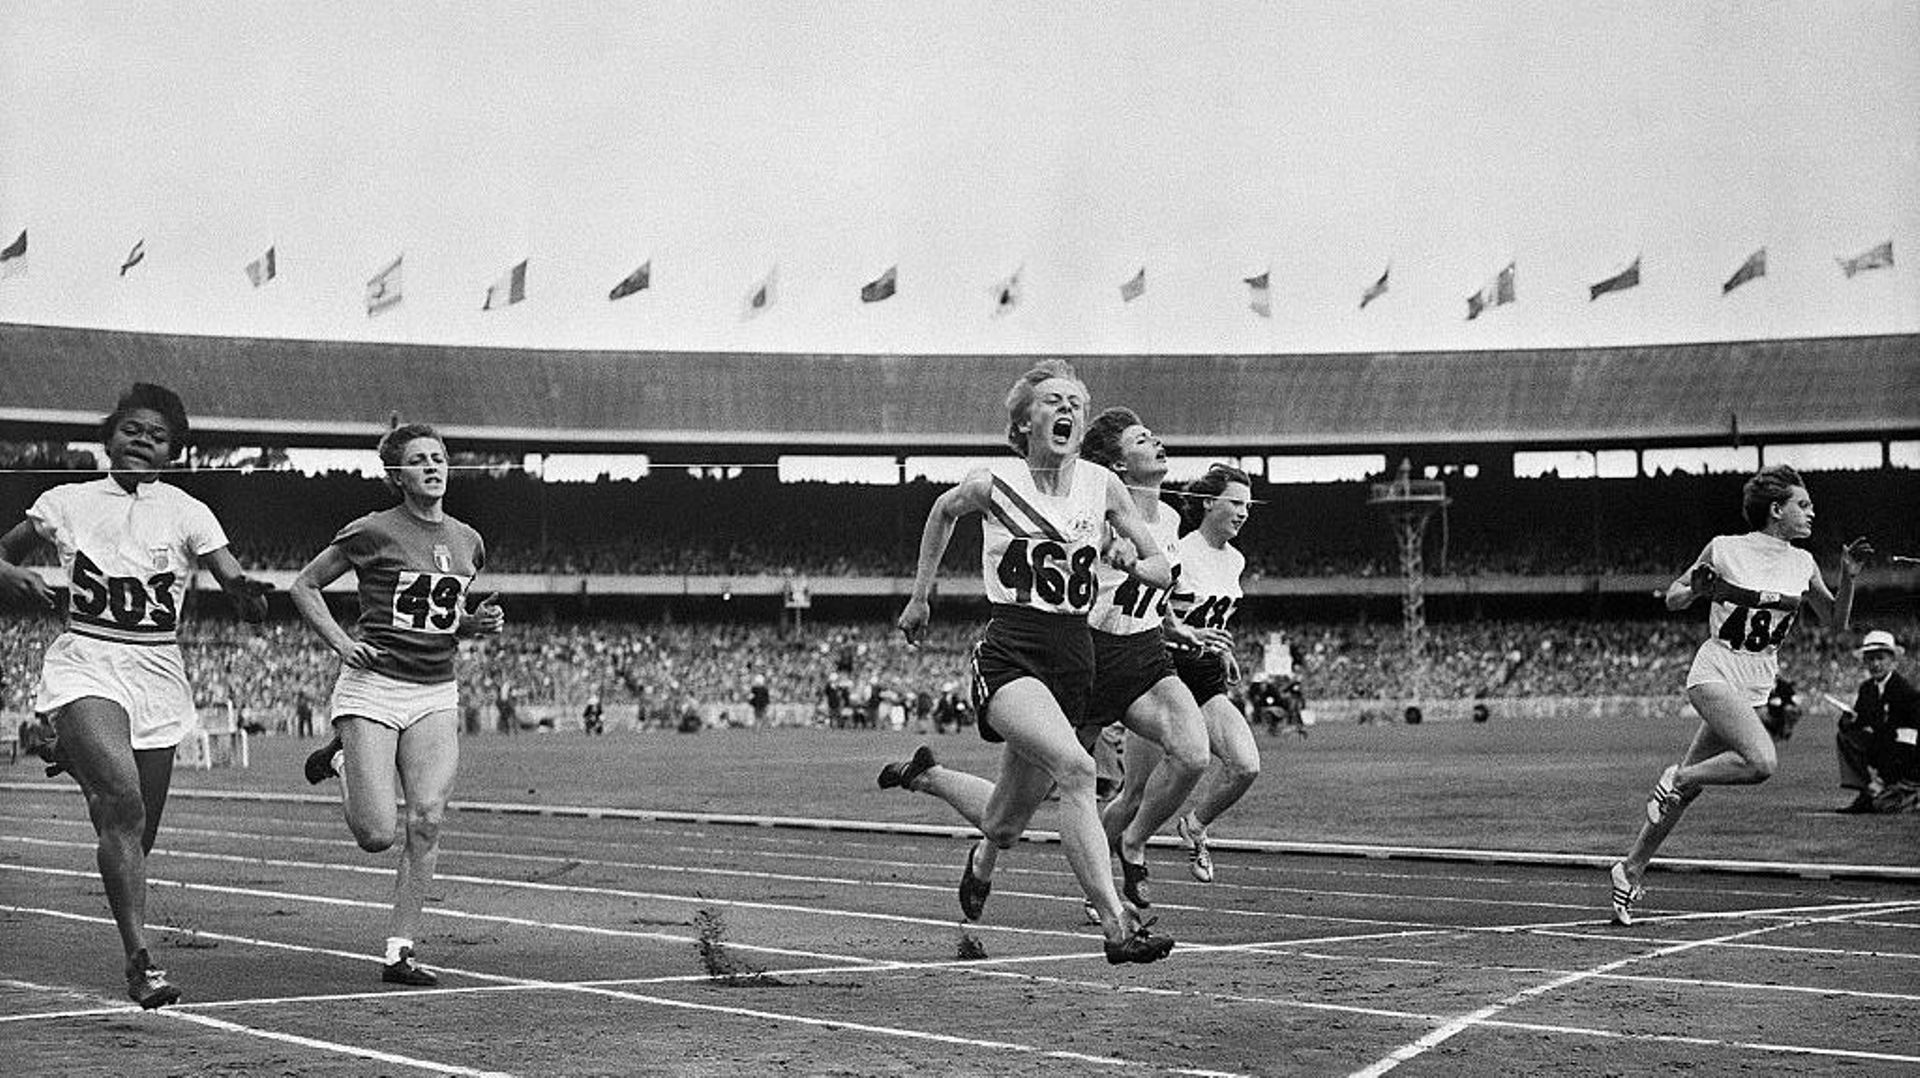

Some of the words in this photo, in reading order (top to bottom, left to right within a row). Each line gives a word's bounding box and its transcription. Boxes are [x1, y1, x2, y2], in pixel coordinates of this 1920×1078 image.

[72, 550, 176, 630] 503
[396, 575, 461, 629] 49
[997, 540, 1097, 609] 468
